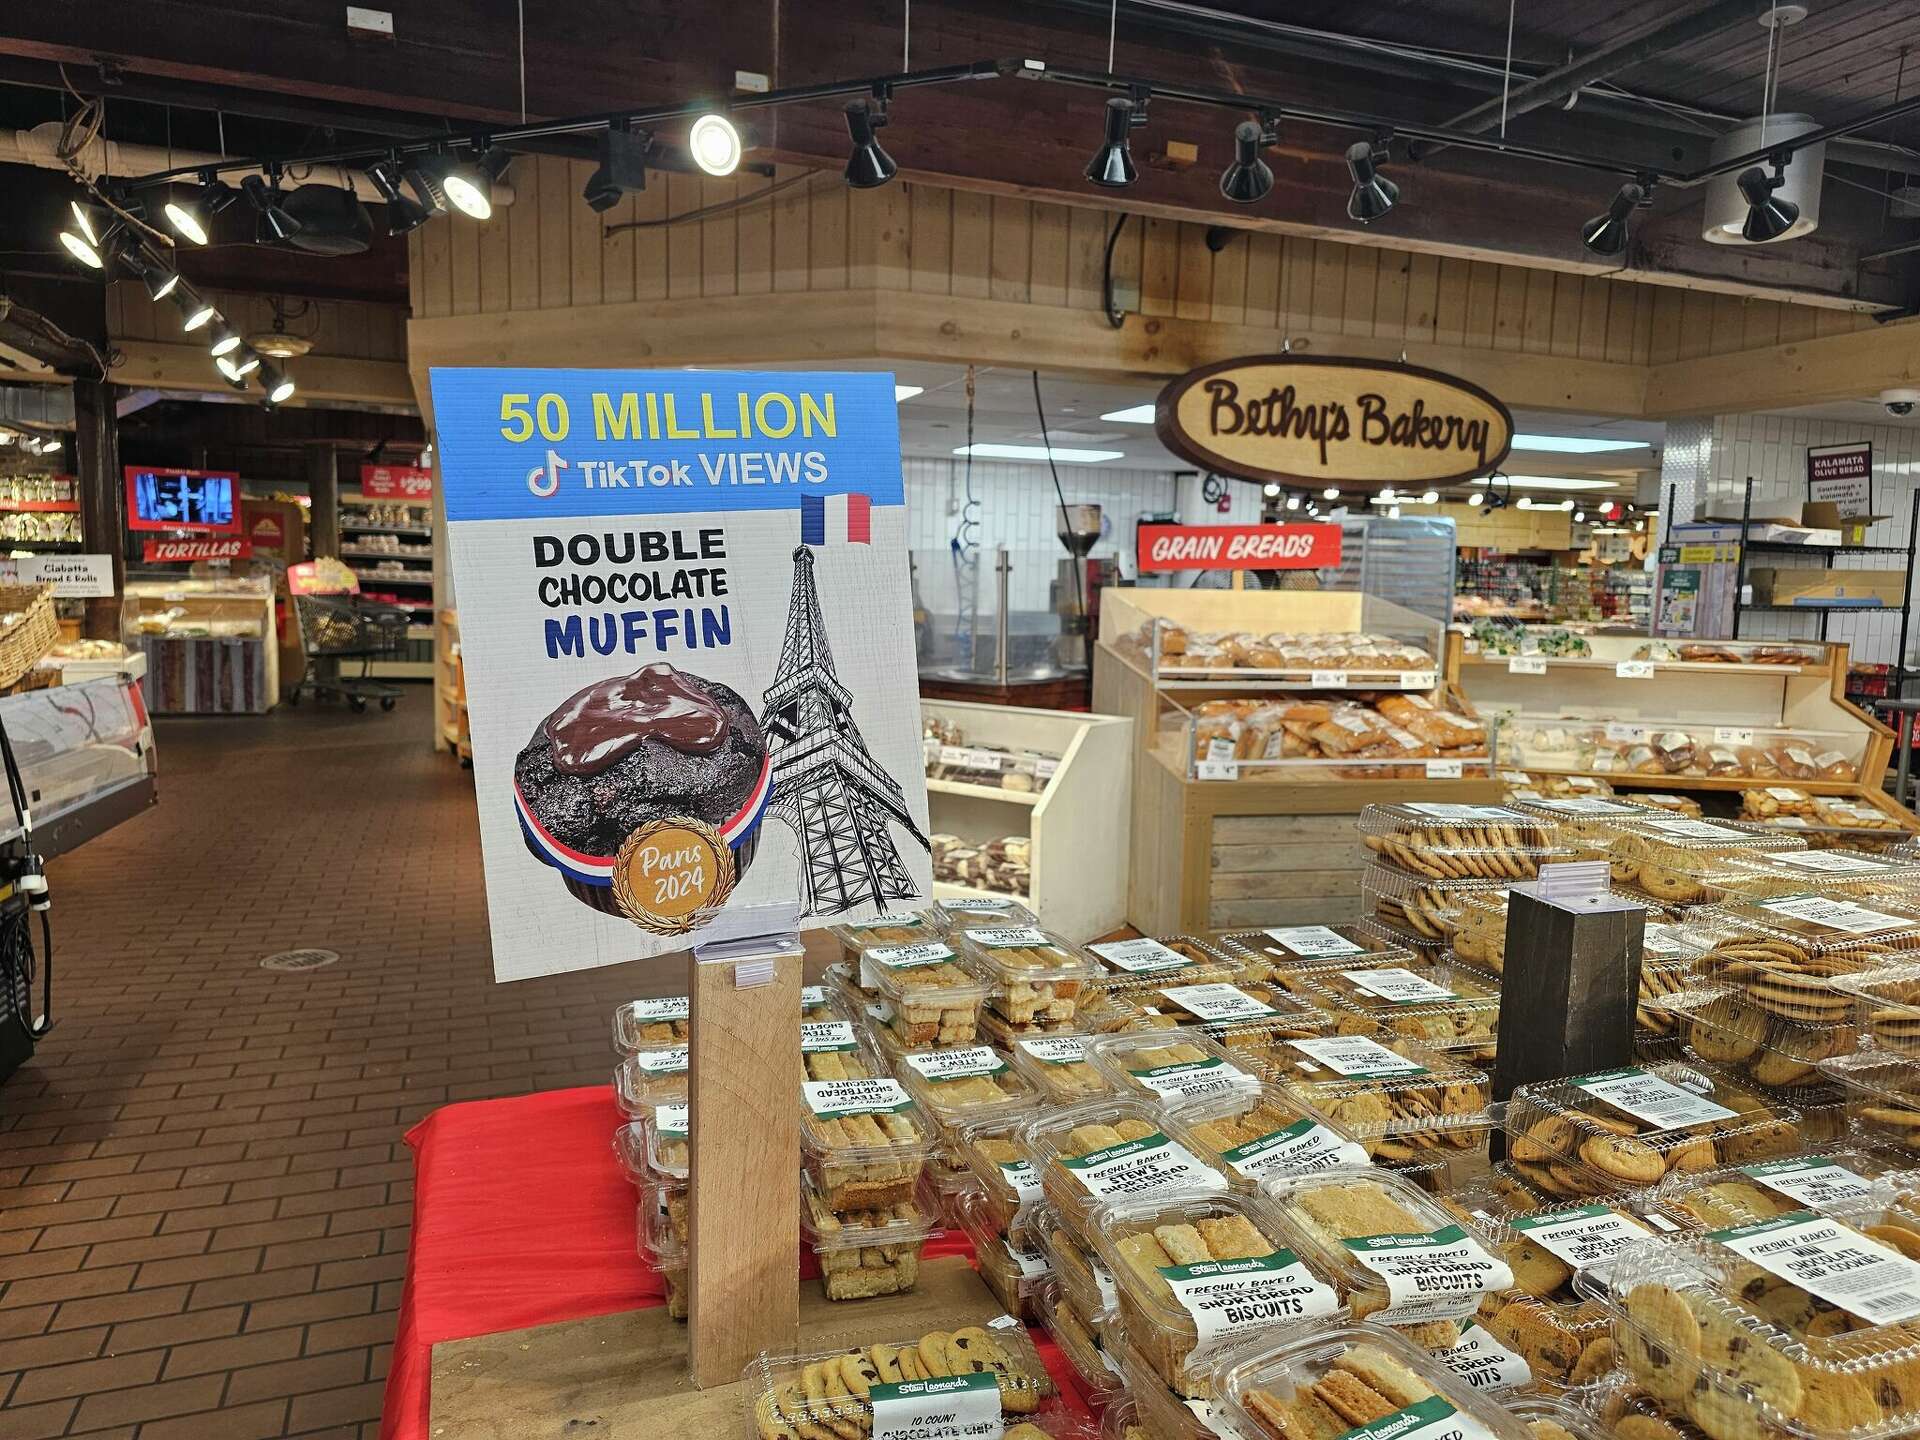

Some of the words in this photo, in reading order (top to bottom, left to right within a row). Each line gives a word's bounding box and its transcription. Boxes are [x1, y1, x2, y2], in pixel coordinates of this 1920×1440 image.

[500, 393, 570, 442] 50
[592, 392, 837, 442] MILLION
[1204, 378, 1349, 465] Bethy's
[1357, 393, 1489, 468] Bakery
[576, 459, 692, 489] TikTok
[698, 451, 829, 487] VIEWS
[1814, 456, 1864, 468] KALAMATA
[1814, 467, 1837, 477] OLIVE
[1839, 465, 1864, 475] BREAD
[156, 541, 241, 559] TORTILLAS
[533, 528, 726, 568] DOUBLE
[1151, 537, 1223, 561] GRAIN
[1226, 533, 1314, 560] BREADS
[44, 564, 88, 573] Ciabatta
[537, 568, 729, 608] CHOCOLATE
[544, 604, 732, 659] MUFFIN
[640, 845, 702, 877] Paris
[655, 866, 705, 904] 2024
[802, 1022, 843, 1031] SHORTB
[803, 1029, 832, 1037] STEW
[918, 1051, 987, 1063] SHORTBREAD
[940, 1058, 977, 1068] STEW'S
[826, 1080, 877, 1089] BISCUITS
[1150, 1073, 1190, 1085] FRESHLY
[1194, 1070, 1223, 1079] BAKED
[1595, 1083, 1629, 1093] FRESHLY
[1629, 1079, 1654, 1087] BAKED
[817, 1085, 893, 1098] SHORTBREAD
[1181, 1079, 1235, 1097] BISCUITS
[840, 1094, 882, 1102] STEW'S
[1244, 1150, 1286, 1171] FRESHLY
[1289, 1135, 1320, 1154] BAKED
[1087, 1161, 1133, 1180] FRESHLY
[1136, 1151, 1171, 1166] BAKED
[1109, 1164, 1159, 1184] STEW'S
[1100, 1165, 1190, 1195] SHORTBREAD
[1123, 1173, 1184, 1194] BISCUITS
[1774, 1175, 1812, 1187] FRESHLY
[1814, 1172, 1843, 1181] BAKED
[1802, 1183, 1863, 1196] CHOCOLATE
[1834, 1188, 1871, 1199] COOKIE
[1542, 1228, 1584, 1241] FRESHLY
[1588, 1221, 1620, 1233] BAKED
[1367, 1236, 1394, 1248] Stew
[1568, 1236, 1634, 1254] CHOCOLATE
[1749, 1237, 1797, 1256] FRESHLY
[1800, 1228, 1838, 1243] BAKED
[1792, 1244, 1824, 1257] MINI
[1370, 1254, 1424, 1263] FRESHLY
[1428, 1249, 1469, 1258] BAKED
[1397, 1258, 1453, 1267] STEW'S
[1574, 1250, 1600, 1261] CHIP
[1785, 1247, 1864, 1271] CHOCOLATE
[1188, 1262, 1217, 1276] Stew
[1216, 1259, 1266, 1273] Leonard's
[1388, 1261, 1493, 1276] SHORTBREAD
[1796, 1267, 1828, 1280] CHIP
[1830, 1254, 1885, 1273] COOKIES
[1185, 1281, 1245, 1296] FRESHLY
[1251, 1275, 1296, 1288] BAKED
[1414, 1273, 1484, 1292] BISCUITS
[1198, 1286, 1314, 1311] SHORTBREAD
[1212, 1285, 1276, 1299] STEW'S
[1224, 1298, 1304, 1324] BISCUITS
[1441, 1340, 1479, 1357] BAKED
[1447, 1355, 1506, 1373] TBREAD
[899, 1382, 924, 1394] Stew
[925, 1377, 968, 1392] Leonard's
[1460, 1367, 1502, 1387] UITS
[912, 1417, 922, 1426] 10
[925, 1413, 956, 1425] COUNT
[1366, 1413, 1421, 1439] Leonard's
[882, 1426, 960, 1440] CHOCOLATE
